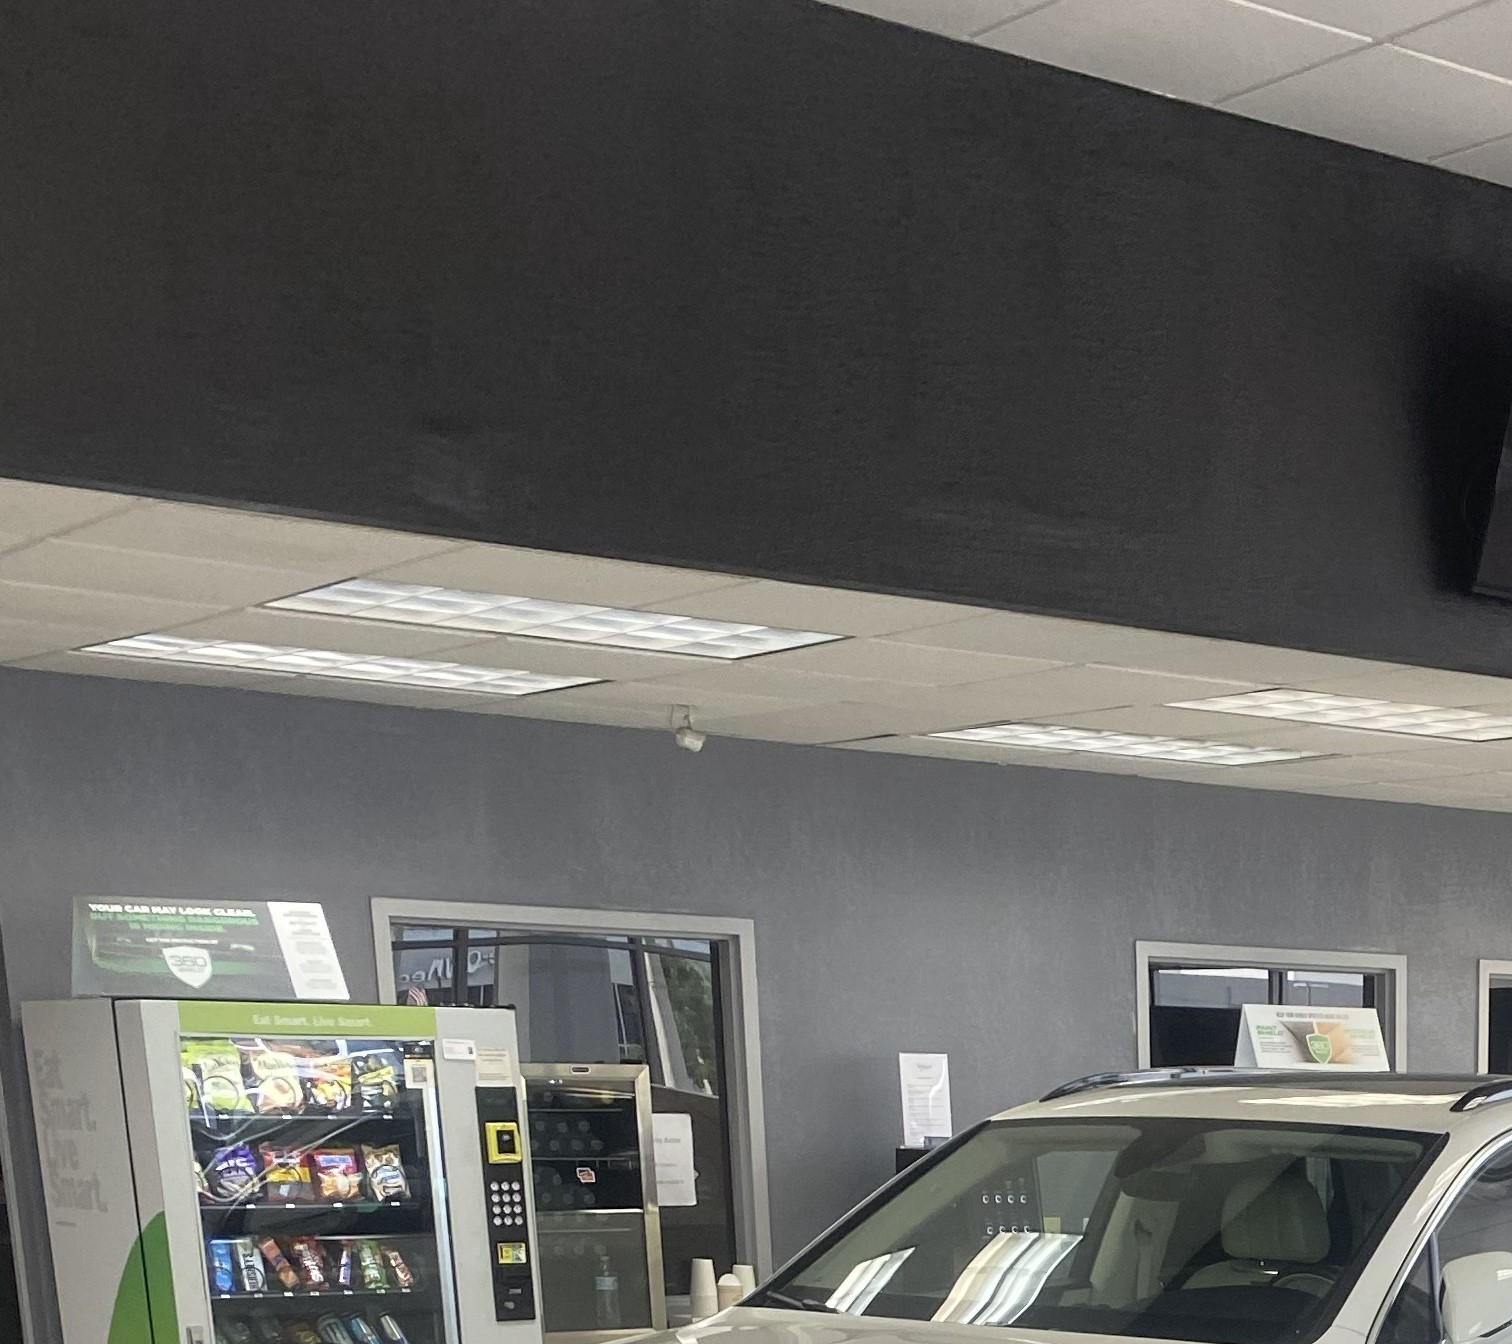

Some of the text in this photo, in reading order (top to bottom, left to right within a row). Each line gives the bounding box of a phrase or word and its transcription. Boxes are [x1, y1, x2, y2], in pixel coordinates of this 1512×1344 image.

[88, 903, 123, 913] YOUR
[124, 905, 150, 914] CAR
[151, 906, 177, 915] MAY
[178, 907, 212, 916] LOOK
[169, 955, 207, 967] 360
[252, 1014, 271, 1025] Eat
